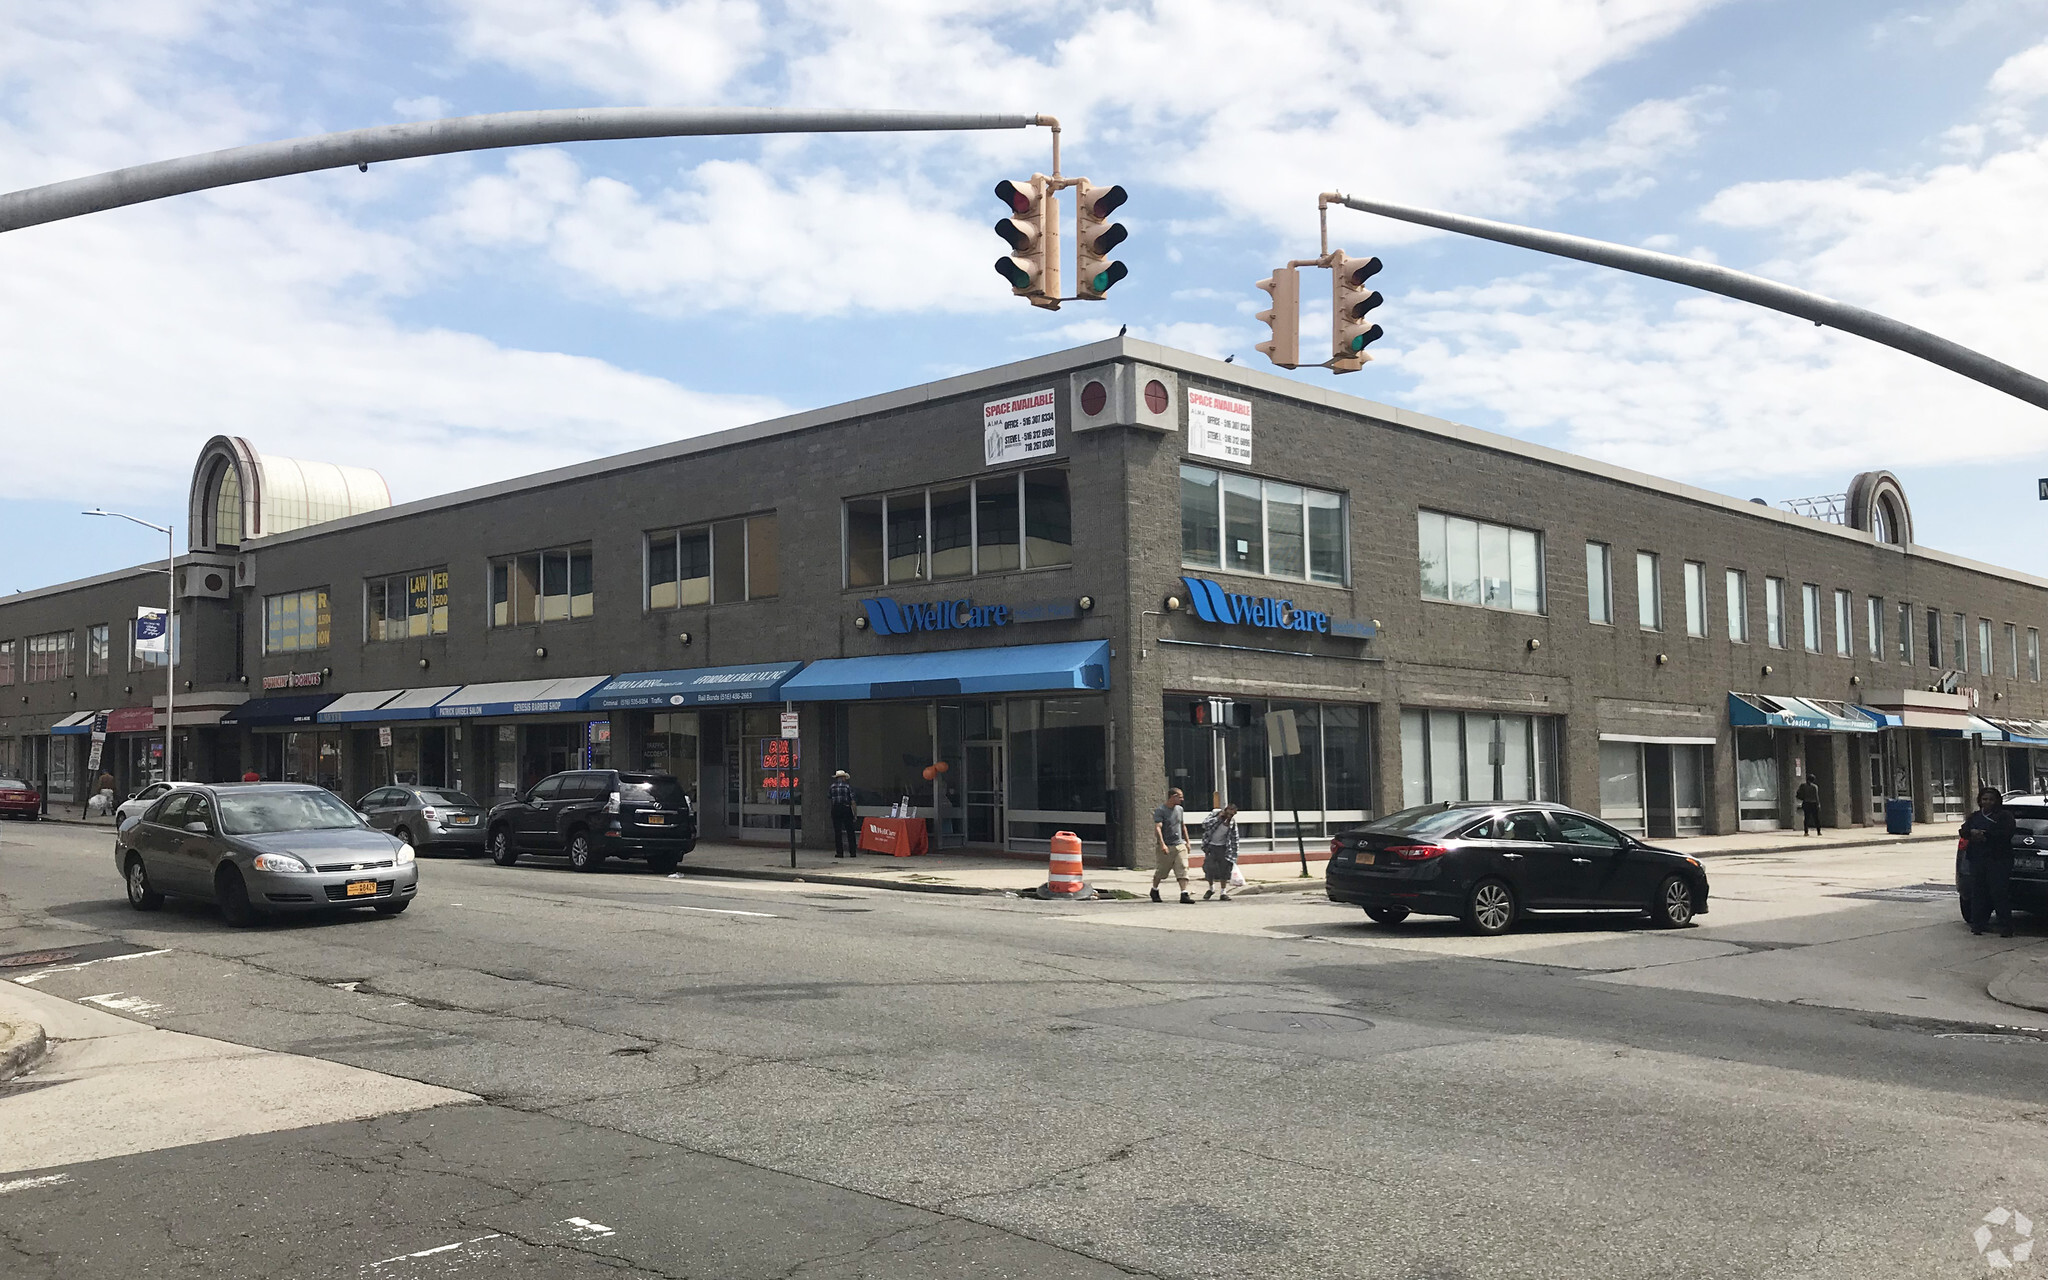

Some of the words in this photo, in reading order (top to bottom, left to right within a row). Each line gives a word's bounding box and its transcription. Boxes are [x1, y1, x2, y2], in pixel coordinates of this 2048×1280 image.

[986, 402, 1010, 417] SPACE
[1012, 393, 1053, 412] AVAILABLE
[1190, 393, 1212, 407] SPACE
[1214, 398, 1250, 416] AVAILABLE
[1004, 419, 1018, 429] OFFICE
[1005, 435, 1018, 444] STEVE
[410, 572, 448, 593] LAWYER
[901, 598, 1007, 632] WellCare
[1229, 593, 1327, 633] WellCare
[294, 671, 321, 686] DONUTS
[440, 707, 454, 716] PATRICK
[455, 707, 468, 715] UNISEX
[469, 706, 482, 715] SALON
[514, 703, 531, 712] GENESIS
[532, 702, 548, 711] BARBER
[550, 702, 561, 710] SHOP
